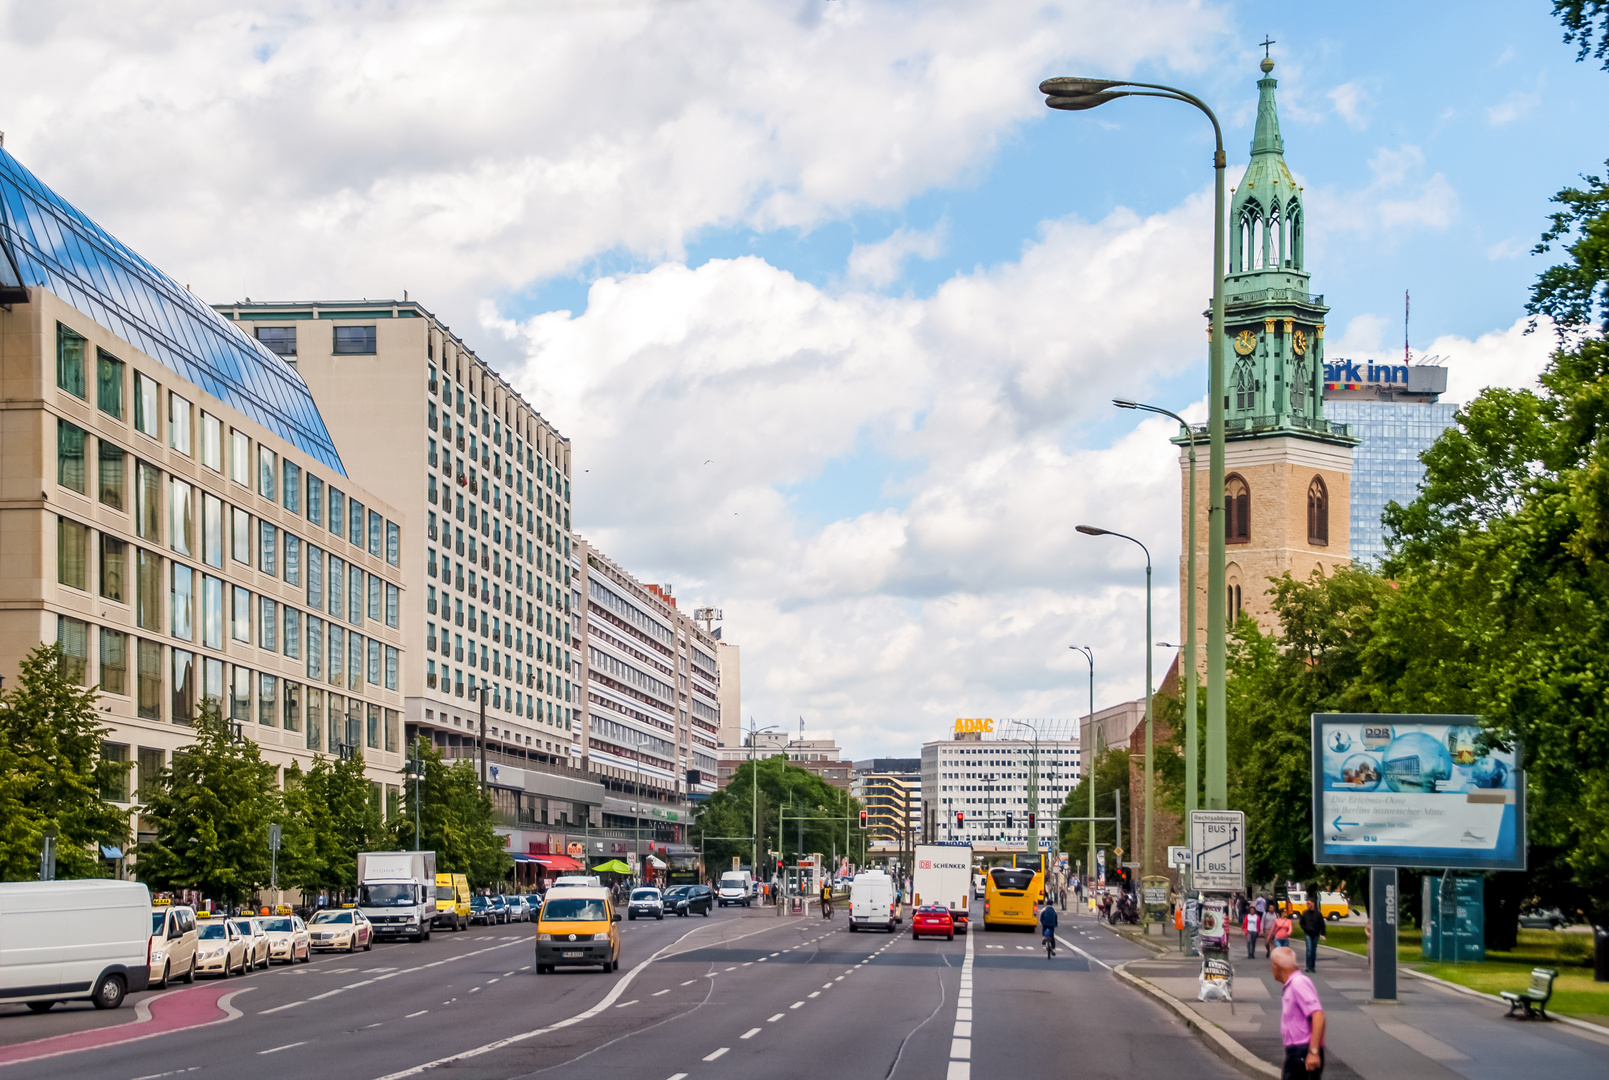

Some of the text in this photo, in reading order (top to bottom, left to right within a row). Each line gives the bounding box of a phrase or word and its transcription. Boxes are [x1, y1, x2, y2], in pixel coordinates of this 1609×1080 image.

[1368, 359, 1408, 383] inn
[954, 718, 993, 733] ADAC
[1365, 728, 1390, 736] DDR
[1331, 795, 1406, 804] Die Erlebnis-Oase
[1342, 805, 1371, 814] Berlins
[1373, 806, 1420, 816] historischer
[1208, 825, 1226, 833] BUS
[920, 861, 930, 869] DB
[1208, 863, 1226, 871] BUS
[1386, 884, 1394, 924] STRÖER
